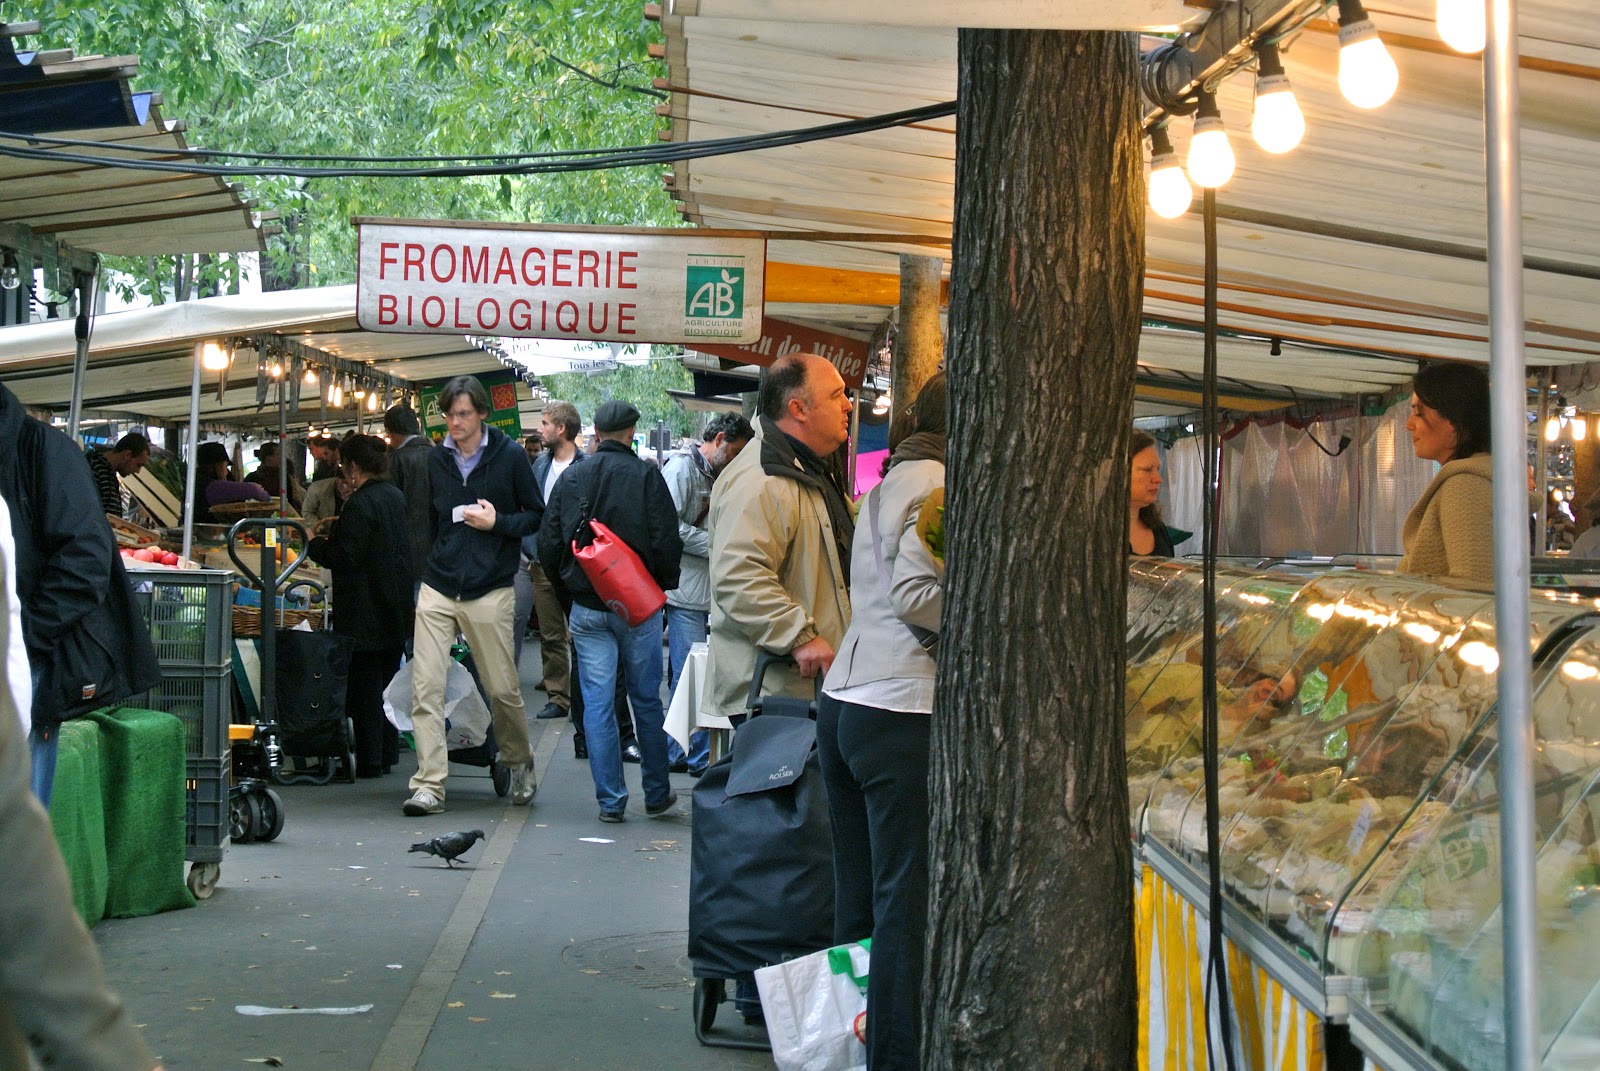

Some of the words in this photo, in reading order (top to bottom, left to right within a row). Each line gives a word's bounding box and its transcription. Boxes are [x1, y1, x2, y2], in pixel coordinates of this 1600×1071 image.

[379, 242, 638, 289] FROMAGERIE
[688, 282, 735, 317] AB
[378, 294, 636, 335] BIOLOGIQUE
[685, 319, 743, 328] AGRICULTURE
[684, 328, 743, 336] BIOLOGIQUE
[569, 361, 590, 370] Tous
[592, 360, 606, 368] les
[769, 770, 794, 780] ROLSER
